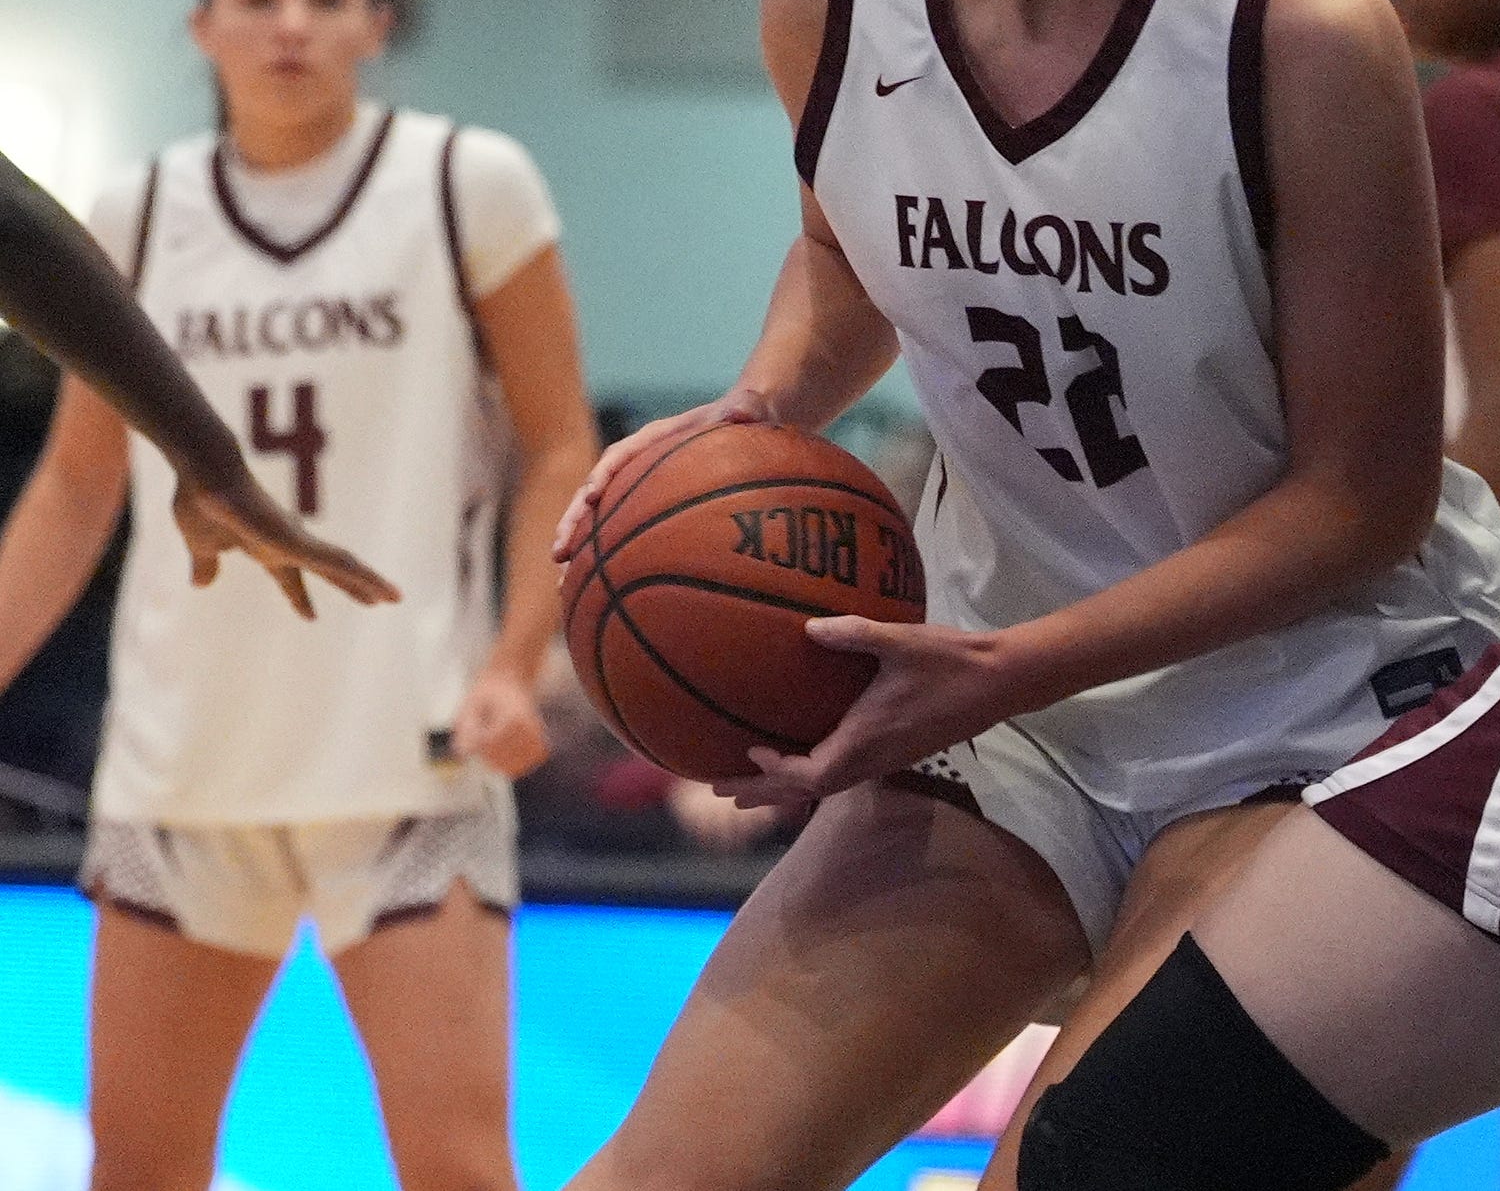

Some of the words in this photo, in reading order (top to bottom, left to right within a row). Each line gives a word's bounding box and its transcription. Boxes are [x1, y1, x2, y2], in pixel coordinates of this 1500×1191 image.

[894, 194, 1171, 297] FALCONS
[177, 293, 409, 359] FALCONS
[965, 306, 1151, 489] 22
[247, 383, 328, 517] 4
[731, 507, 859, 588] ROCK
